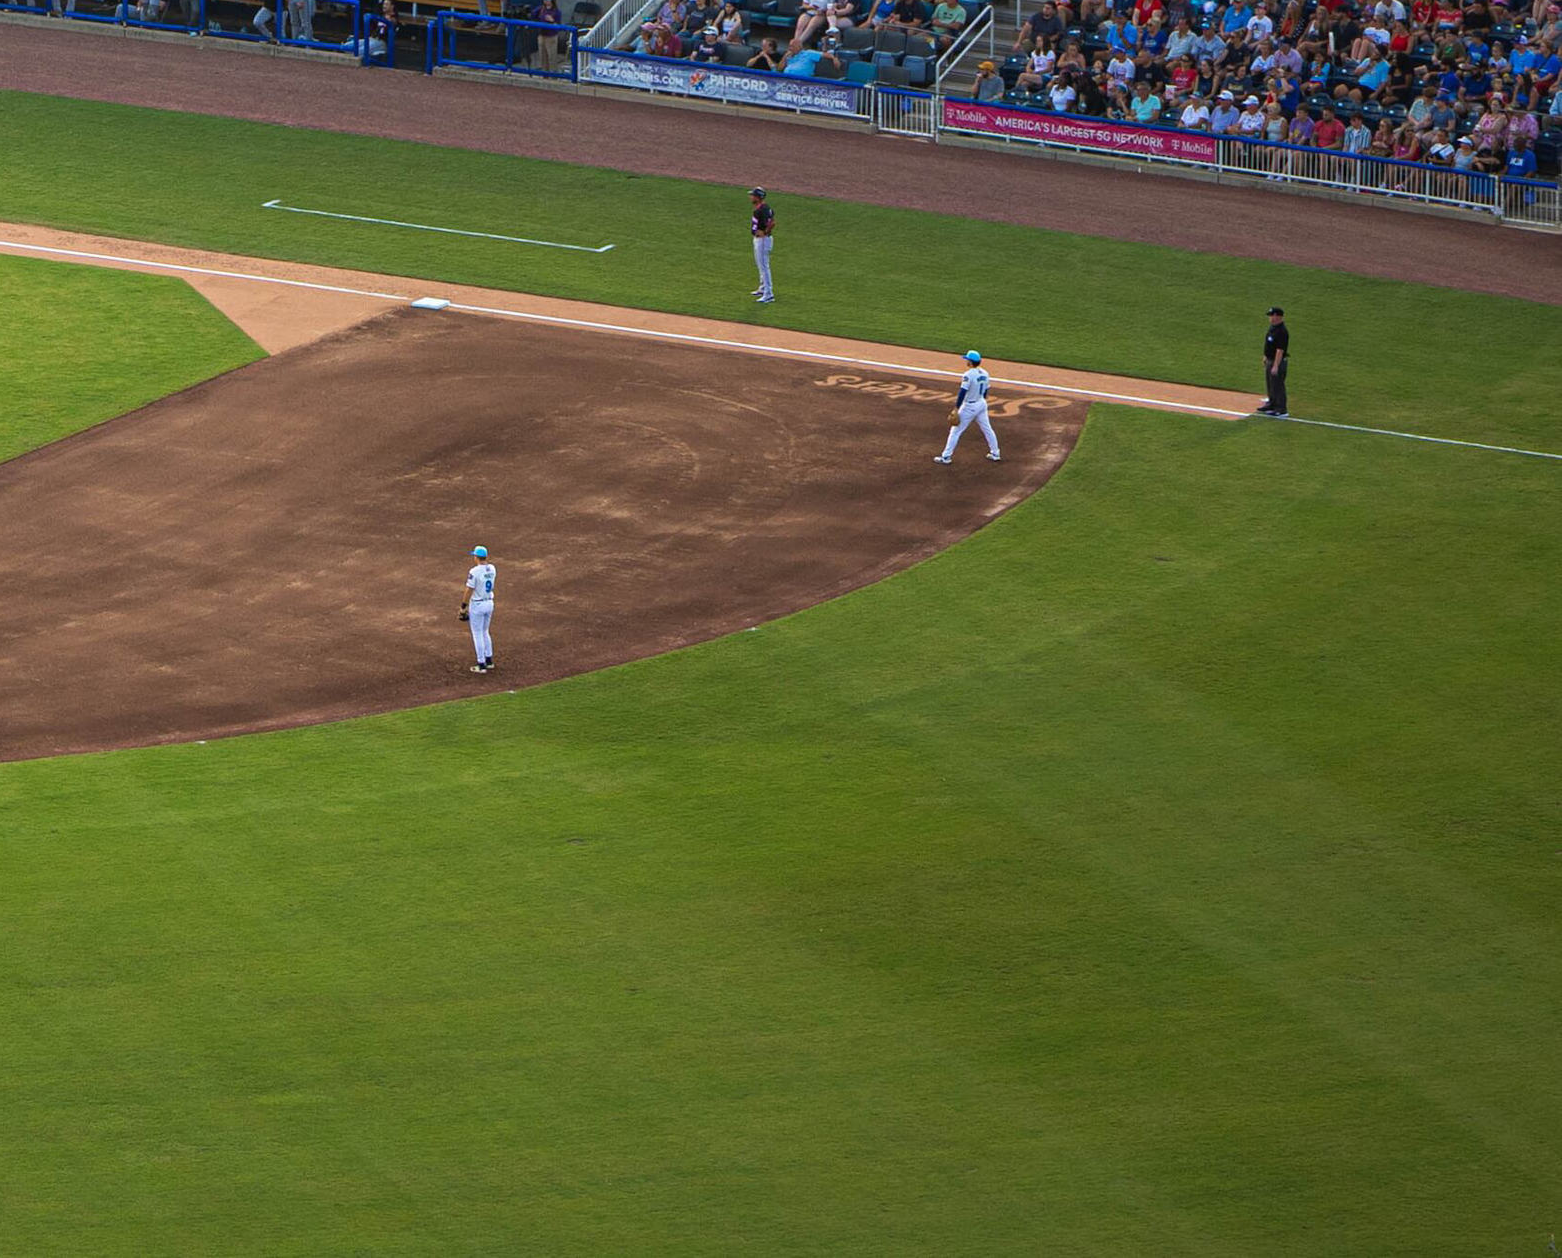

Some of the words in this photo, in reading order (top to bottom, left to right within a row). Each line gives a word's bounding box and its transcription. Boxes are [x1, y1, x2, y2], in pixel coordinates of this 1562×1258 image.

[709, 74, 768, 92] PAFFORD
[776, 92, 812, 104] SERVICE
[956, 109, 987, 124] Mobile
[995, 115, 1050, 133] AMERICA'S
[1051, 125, 1095, 139] LARGEST
[1096, 130, 1111, 141] 5G
[1113, 132, 1164, 148] NETWORK
[1180, 140, 1212, 155] Mobile
[485, 580, 492, 593] 9
